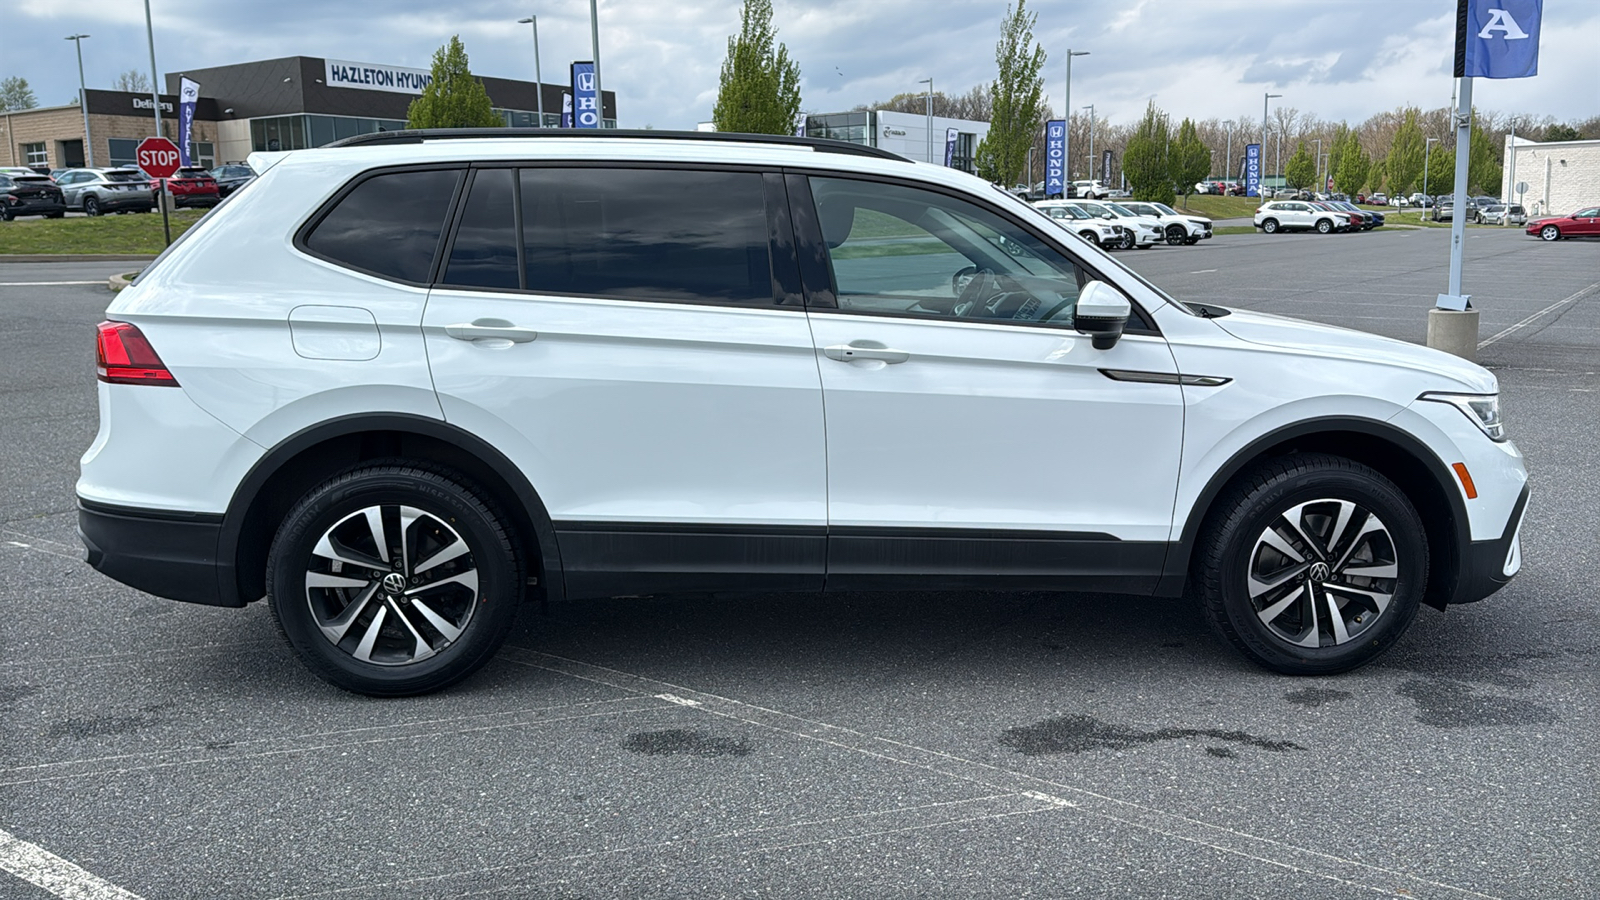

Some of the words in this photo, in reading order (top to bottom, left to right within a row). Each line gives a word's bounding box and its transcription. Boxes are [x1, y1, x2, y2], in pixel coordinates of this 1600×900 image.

[331, 64, 394, 87] HAZLETON
[396, 71, 434, 89] HYUND
[140, 150, 178, 167] STOP
[1049, 140, 1063, 187] HONDA
[1248, 158, 1259, 192] HONDA
